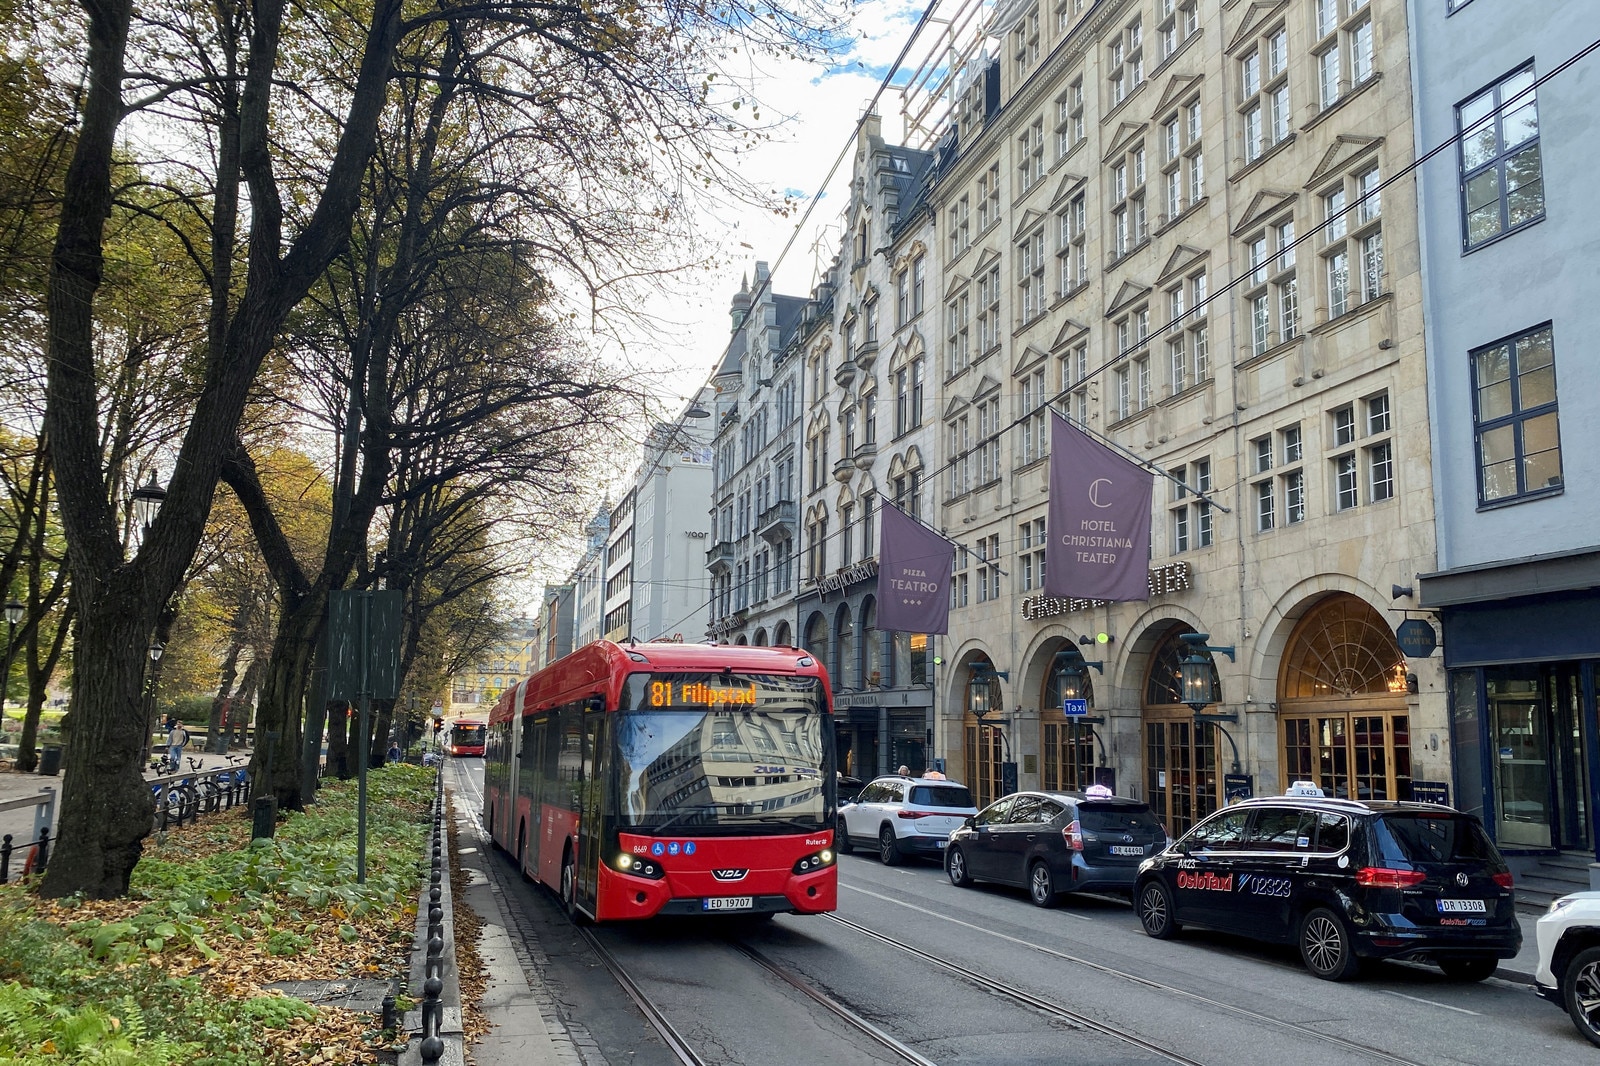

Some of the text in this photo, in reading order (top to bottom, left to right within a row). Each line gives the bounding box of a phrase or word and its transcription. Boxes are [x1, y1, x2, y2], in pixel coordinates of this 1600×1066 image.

[1081, 520, 1116, 531] HOTEL
[1062, 535, 1132, 548] CHRISTIANIA
[1076, 552, 1116, 564] TEATER
[903, 568, 926, 577] PIZZA
[837, 563, 872, 598] JACOBSEN
[890, 578, 937, 593] TEATRO
[651, 681, 756, 707] 81 Filipstad
[1066, 702, 1085, 712] Taxi
[633, 845, 648, 854] 8669
[1177, 859, 1196, 869] A423
[1177, 871, 1292, 898] OsloTaxi 02323
[711, 898, 750, 908] ED 19707
[1443, 901, 1484, 911] DR 13308
